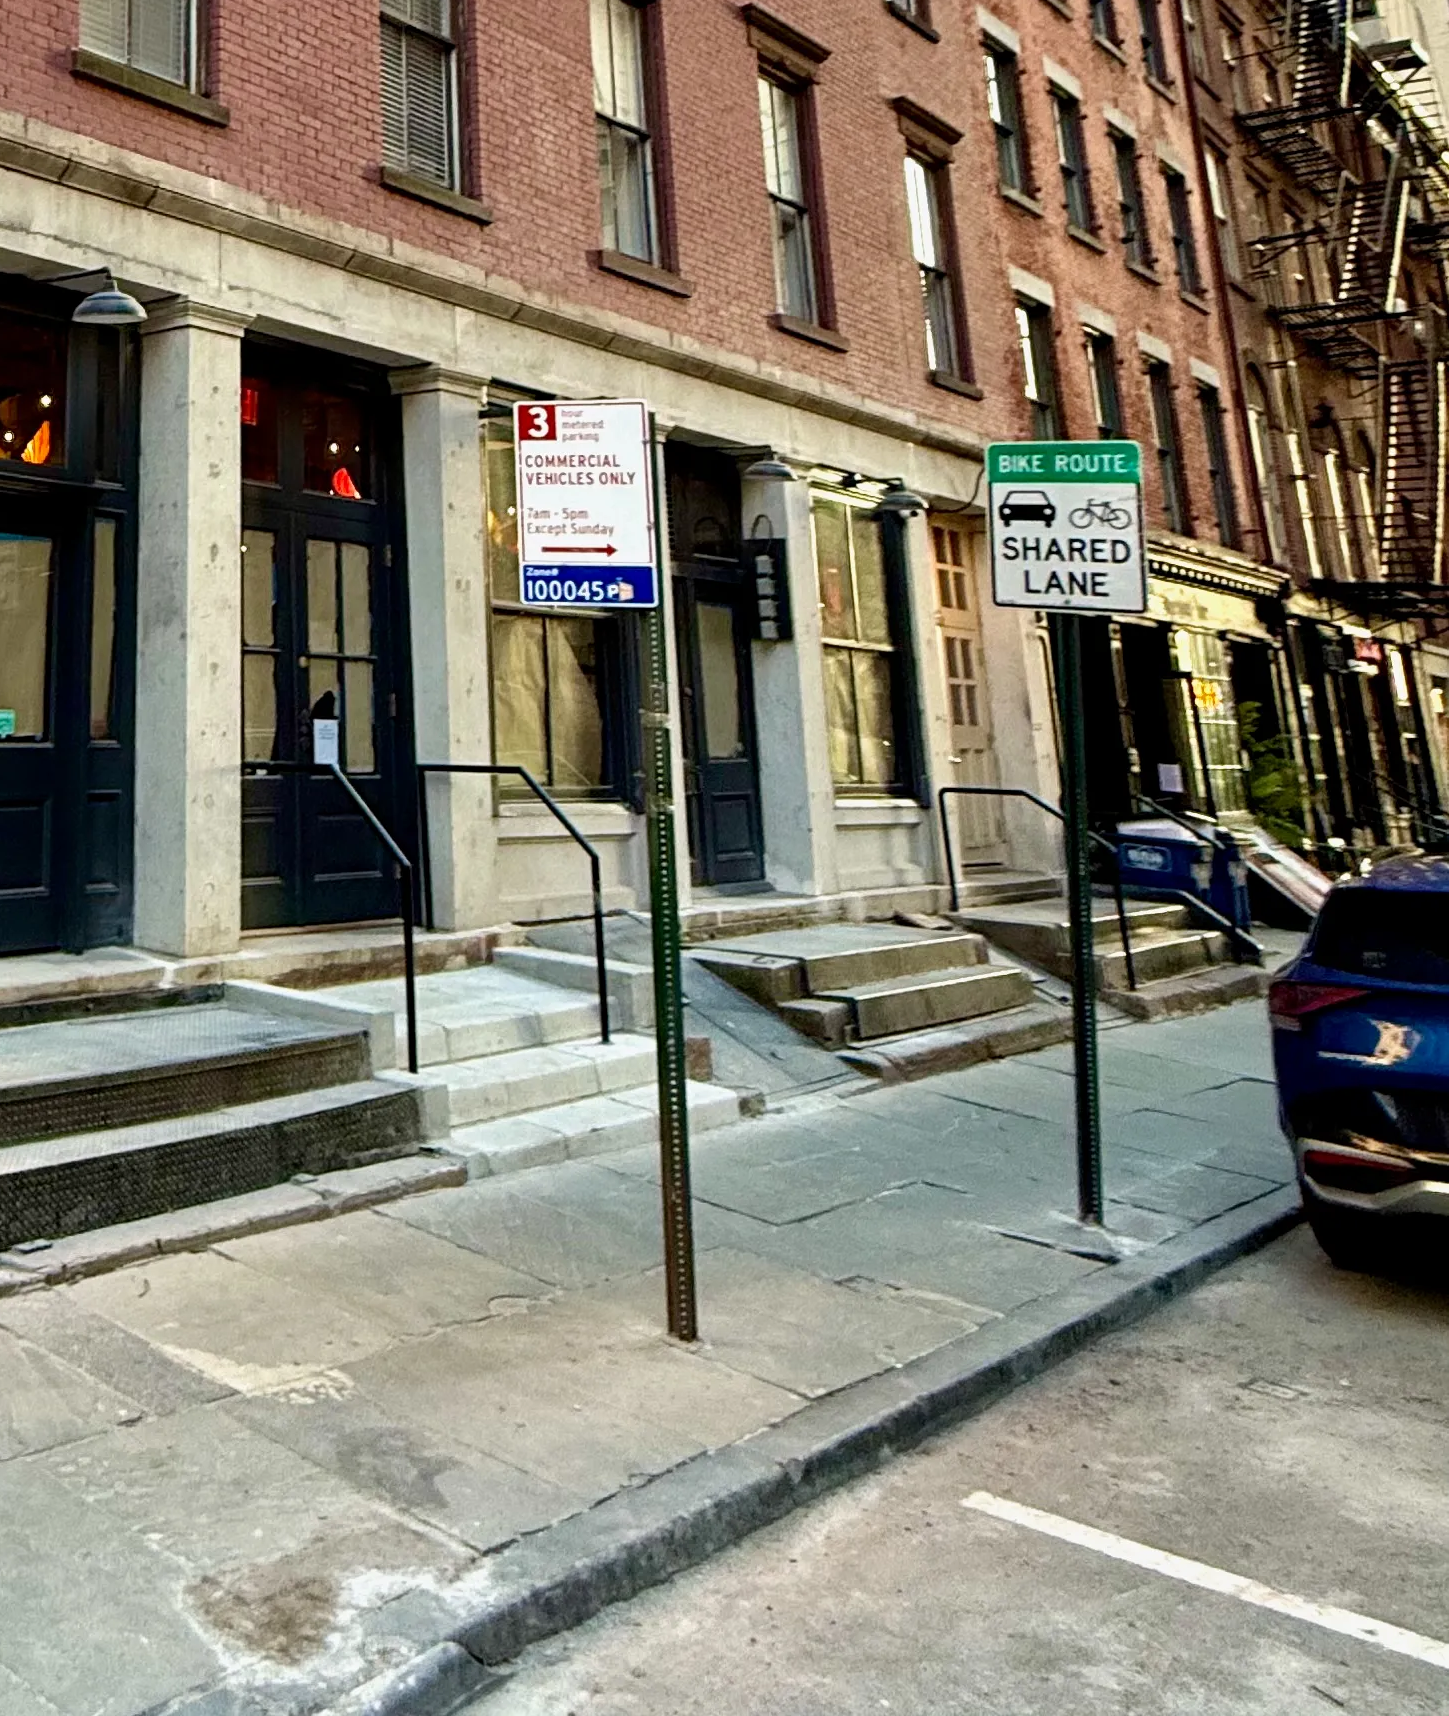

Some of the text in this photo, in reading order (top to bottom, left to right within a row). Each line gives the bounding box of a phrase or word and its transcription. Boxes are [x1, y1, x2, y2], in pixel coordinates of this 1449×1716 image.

[561, 409, 583, 418] hour
[527, 406, 550, 438] 3
[561, 420, 604, 430] metered
[561, 432, 600, 443] parking
[524, 454, 621, 468] COMMERCIAL
[998, 453, 1128, 474] BIKE ROUTE
[525, 471, 636, 485] VEHICLES ONLY
[527, 507, 551, 519] 7am
[562, 507, 589, 521] 5pm
[526, 522, 615, 537] Except Sunday
[1002, 536, 1132, 564] SHARED
[526, 579, 605, 601] 100045
[1023, 569, 1110, 597] LANE
